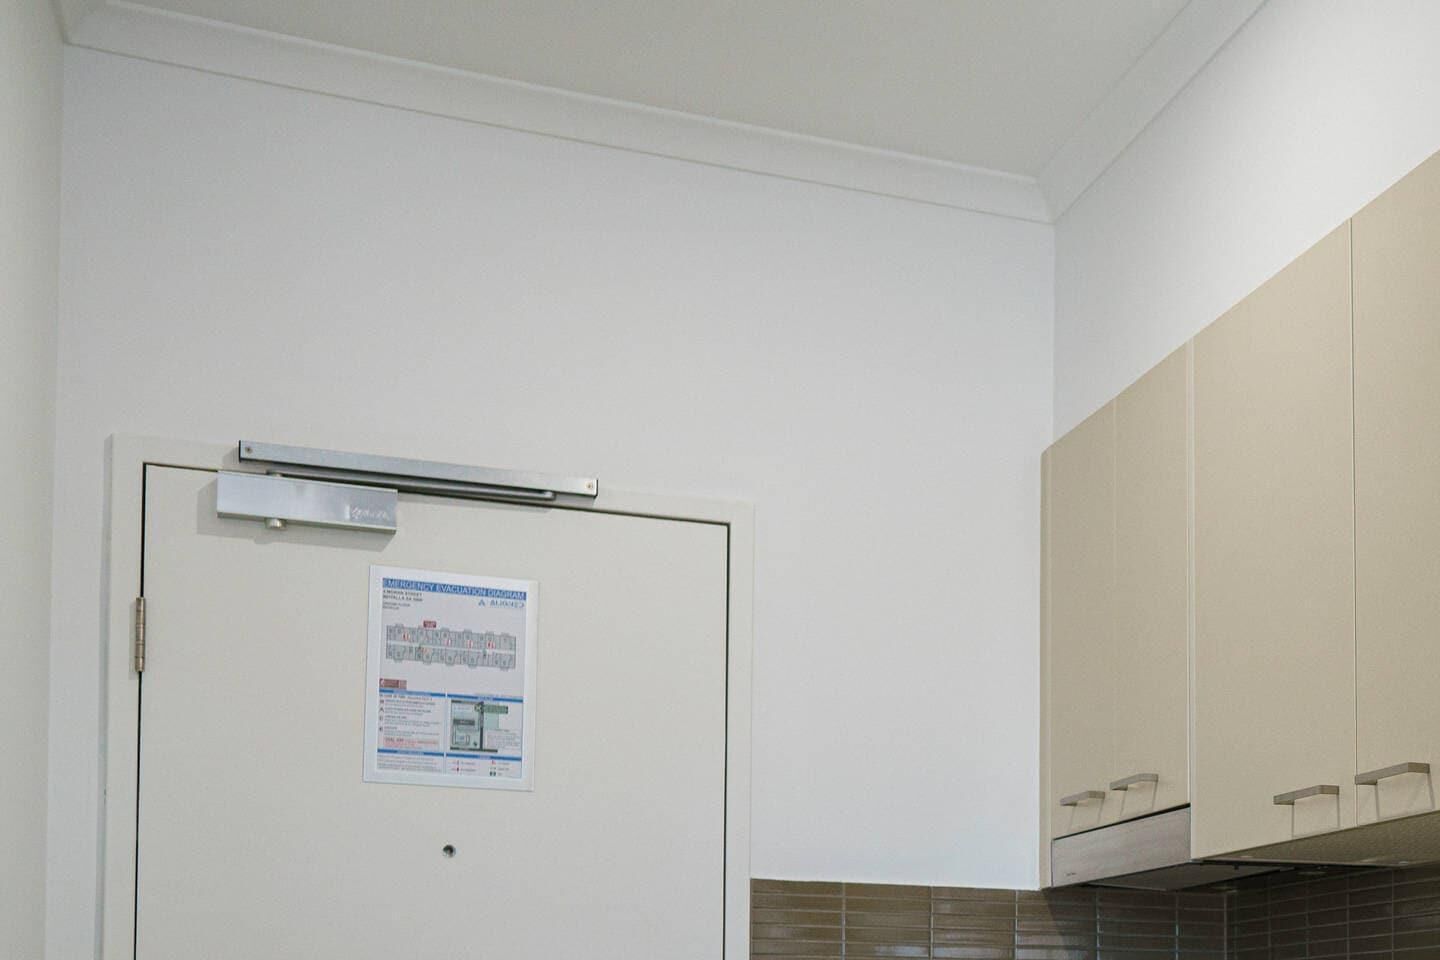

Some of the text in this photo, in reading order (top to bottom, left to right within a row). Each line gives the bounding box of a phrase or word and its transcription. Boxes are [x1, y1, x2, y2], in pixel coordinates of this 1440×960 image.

[384, 579, 525, 600] EMERGENCY EVACUATION DIAGRAM
